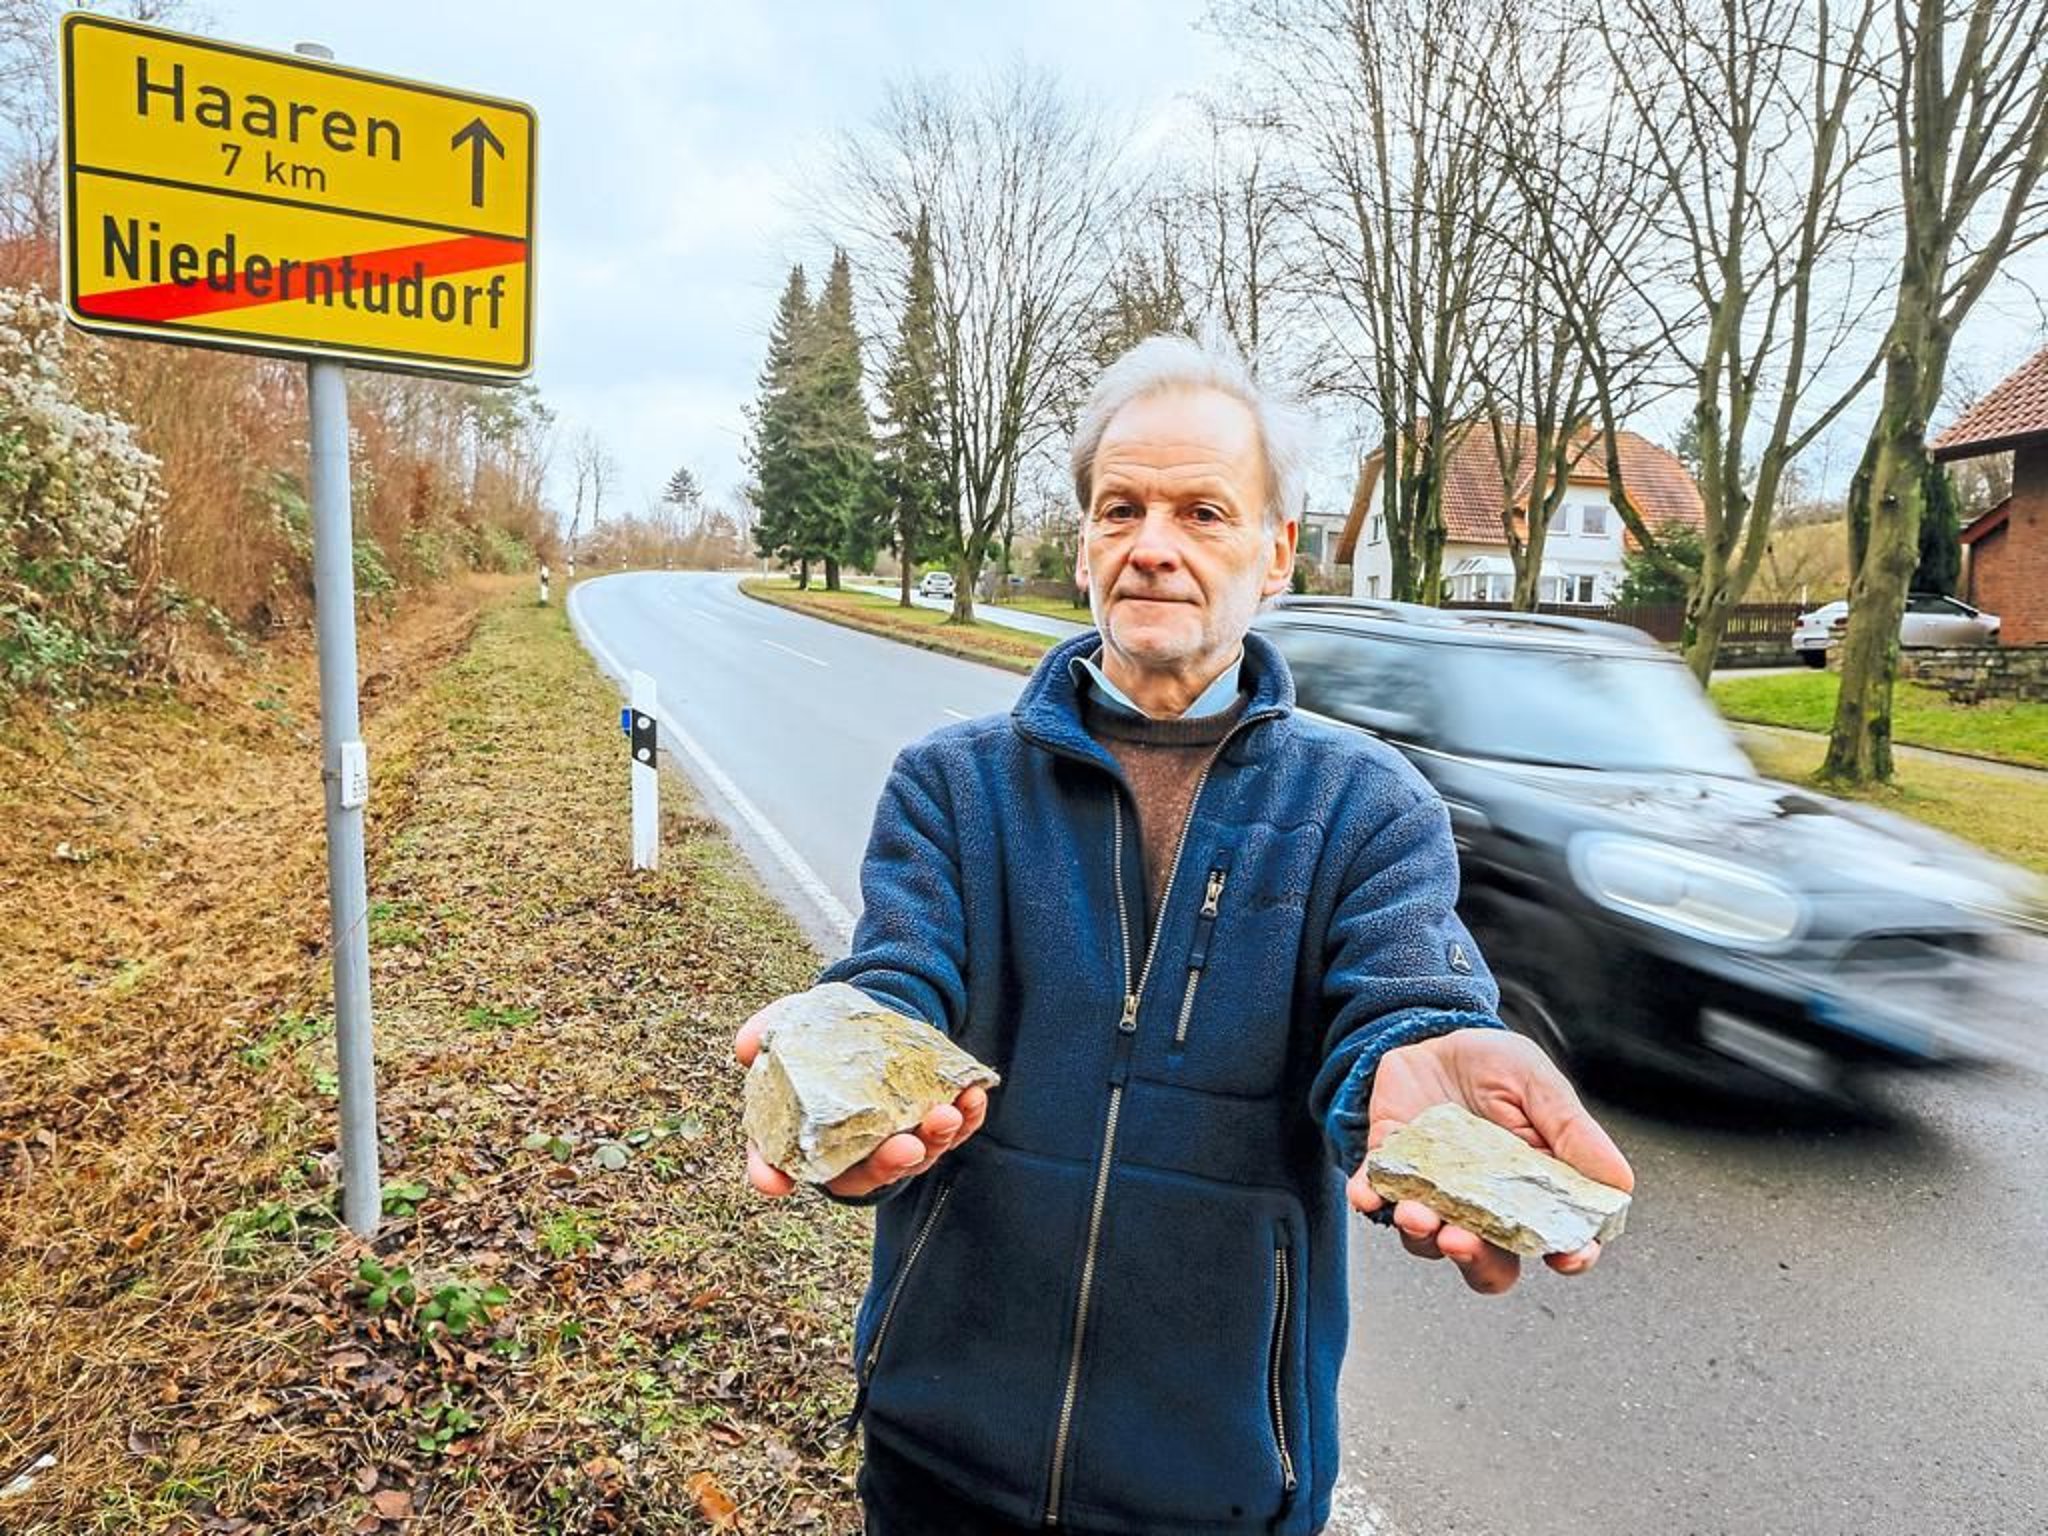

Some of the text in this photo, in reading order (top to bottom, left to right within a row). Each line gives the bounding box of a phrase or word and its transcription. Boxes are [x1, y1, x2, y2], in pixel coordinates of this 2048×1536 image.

[136, 56, 401, 162] Haaren
[220, 144, 326, 192] 7 km
[102, 215, 506, 329] Niederntudorf
